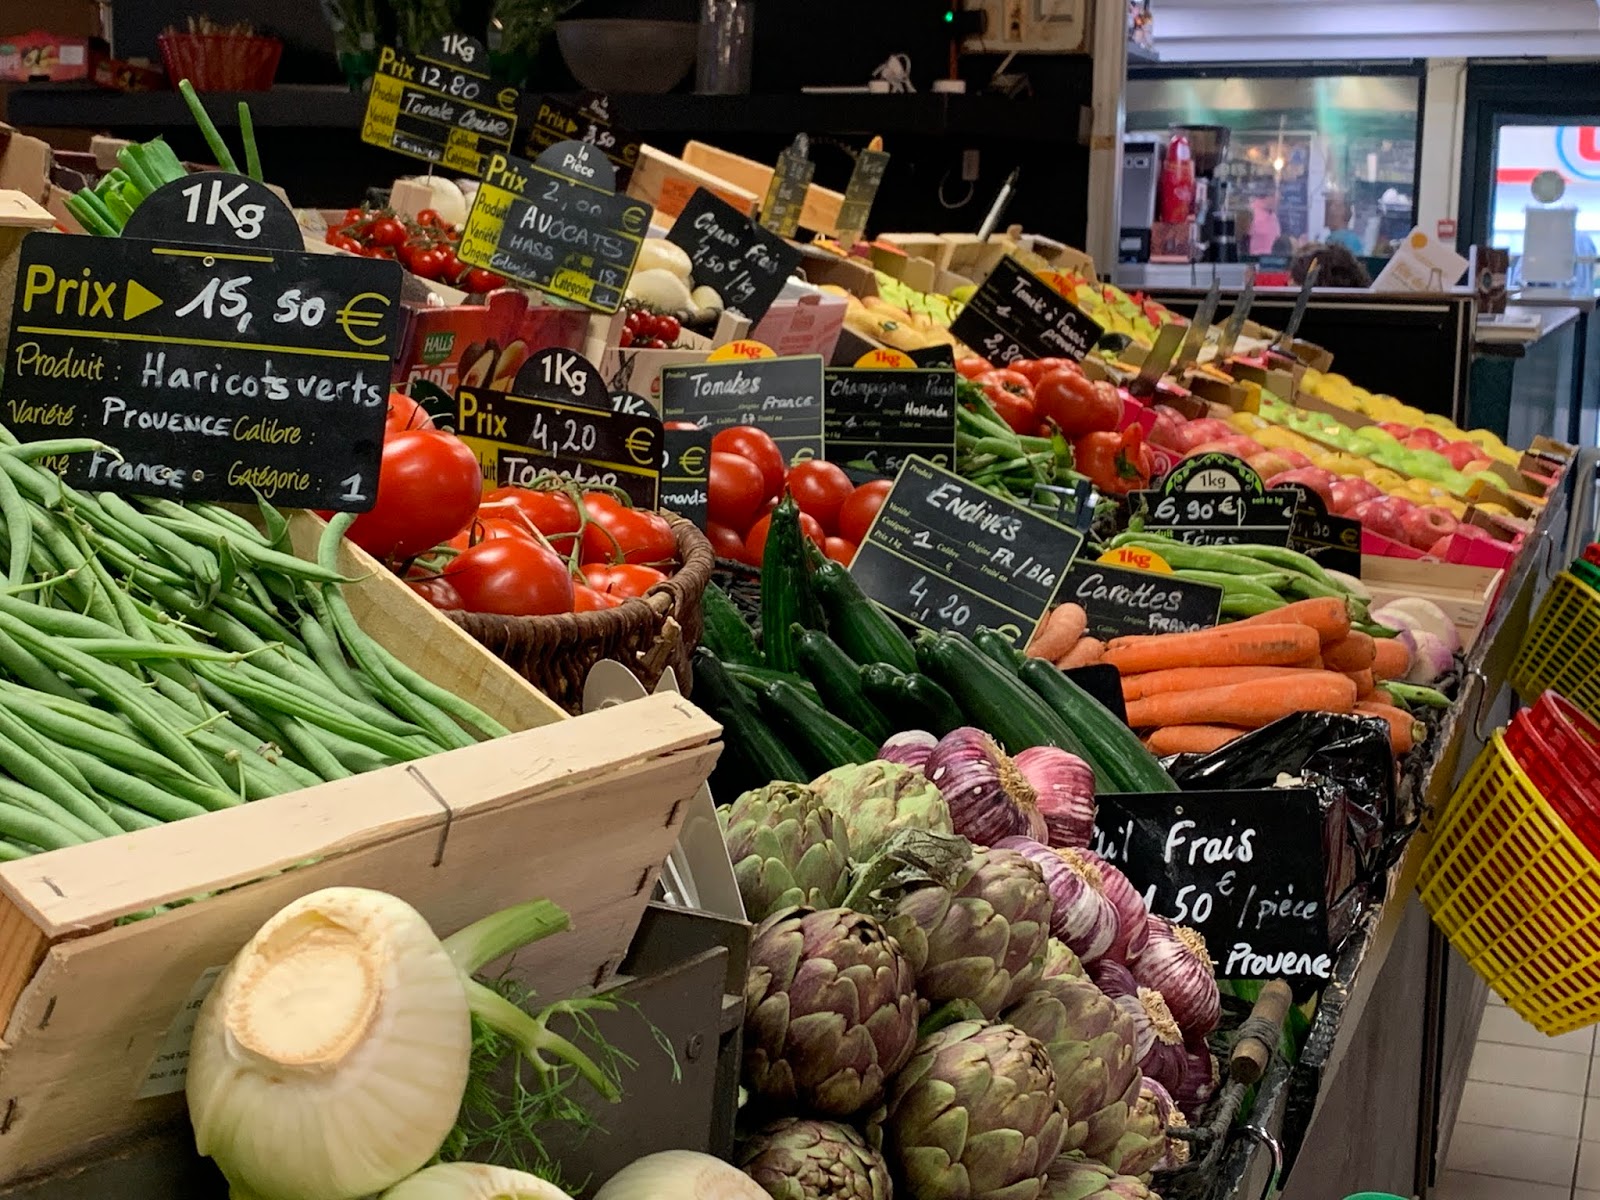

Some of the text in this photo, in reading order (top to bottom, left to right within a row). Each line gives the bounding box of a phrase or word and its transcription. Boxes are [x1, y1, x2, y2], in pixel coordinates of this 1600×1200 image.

[441, 34, 475, 62] 1Kg
[378, 45, 415, 80] Prix
[420, 66, 480, 100] 12,80
[537, 104, 566, 130] Prix
[563, 154, 595, 178] Pièce
[578, 145, 590, 162] la
[486, 154, 528, 193] Prix
[181, 180, 265, 240] 1Kg
[476, 192, 624, 258] Produit AVOCATS
[462, 239, 492, 264] Origine
[510, 235, 554, 260] HASS
[554, 271, 591, 298] Catégorie
[23, 264, 116, 319] Prix
[336, 292, 391, 346] €
[424, 334, 454, 353] HALLS
[732, 342, 762, 360] 1kg
[875, 351, 901, 368] 1kg
[16, 342, 105, 380] Produit
[141, 351, 290, 401] Haricots
[298, 368, 382, 408] verts
[541, 352, 587, 396] 1Kg
[690, 370, 762, 398] Tomates
[762, 395, 814, 411] France
[7, 398, 76, 426] Variété
[233, 415, 303, 445] Calibre
[458, 391, 507, 439] Prix
[531, 412, 598, 458] 4,20
[624, 427, 656, 465] €
[227, 462, 310, 498] Catégorie
[339, 473, 367, 501] 1
[909, 463, 934, 480] Produit
[1201, 472, 1226, 489] 1kg
[874, 529, 889, 541] Prix
[893, 539, 903, 550] kg
[936, 543, 960, 559] Calibre
[967, 540, 992, 557] Origine
[1118, 550, 1152, 569] 1kg
[1076, 573, 1183, 611] Carottes
[1164, 818, 1257, 866] Frais
